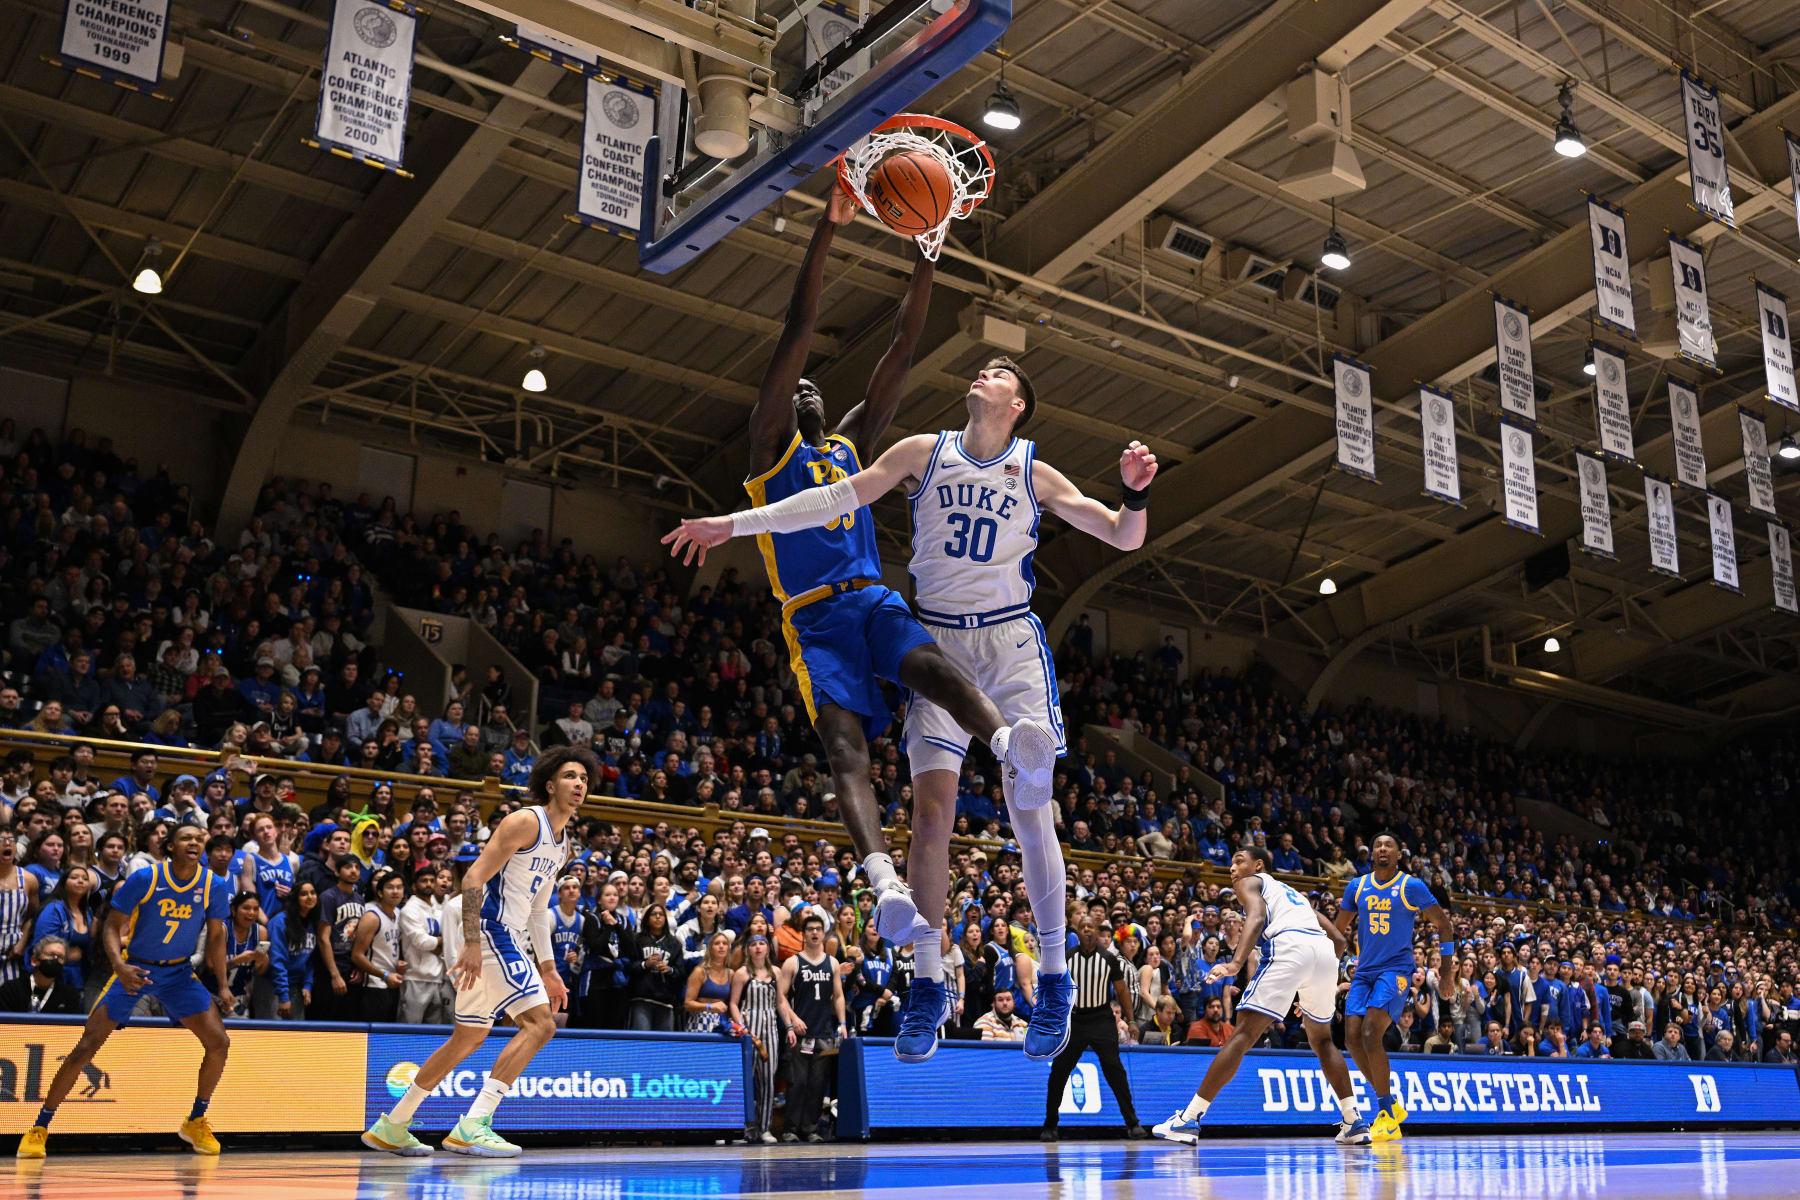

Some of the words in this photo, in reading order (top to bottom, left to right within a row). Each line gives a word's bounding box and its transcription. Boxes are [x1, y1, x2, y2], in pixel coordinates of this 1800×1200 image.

[75, 3, 157, 40] CHAMPIONS
[85, 0, 163, 27] FERENCE
[80, 18, 117, 37] REGULAR
[119, 31, 149, 47] SEASON
[86, 30, 140, 53] TOURNAMENT
[94, 43, 131, 65] 1999
[343, 51, 396, 79] ATLANTIC
[350, 67, 386, 89] COAST
[328, 75, 404, 110] CONFERENCE
[330, 91, 399, 122] CHAMPIONS
[333, 105, 366, 120] REGULAR
[339, 114, 384, 135] TOURNAMENT
[344, 126, 378, 146] 2000
[596, 133, 642, 155] ATLANTIC
[1693, 121, 1722, 159] 35
[602, 148, 634, 165] COAST
[585, 155, 643, 182] CONFERENC
[601, 201, 628, 219] 2001
[936, 483, 1018, 520] DUKE
[944, 512, 998, 562] 30
[260, 868, 292, 882] DUKE
[157, 898, 192, 919] Pitt
[334, 902, 364, 925] DUK
[1365, 895, 1392, 910] Pitt
[162, 920, 180, 943] 7
[1369, 912, 1390, 934] 55
[801, 969, 831, 982] Duke
[867, 960, 890, 973] DUKE
[896, 959, 915, 971] Duk
[876, 971, 881, 985] 1
[905, 972, 910, 987] 1
[814, 983, 820, 1000] 1
[482, 1070, 627, 1098] ucation
[631, 1073, 727, 1104] Lottery
[1258, 1068, 1371, 1111] DUKE
